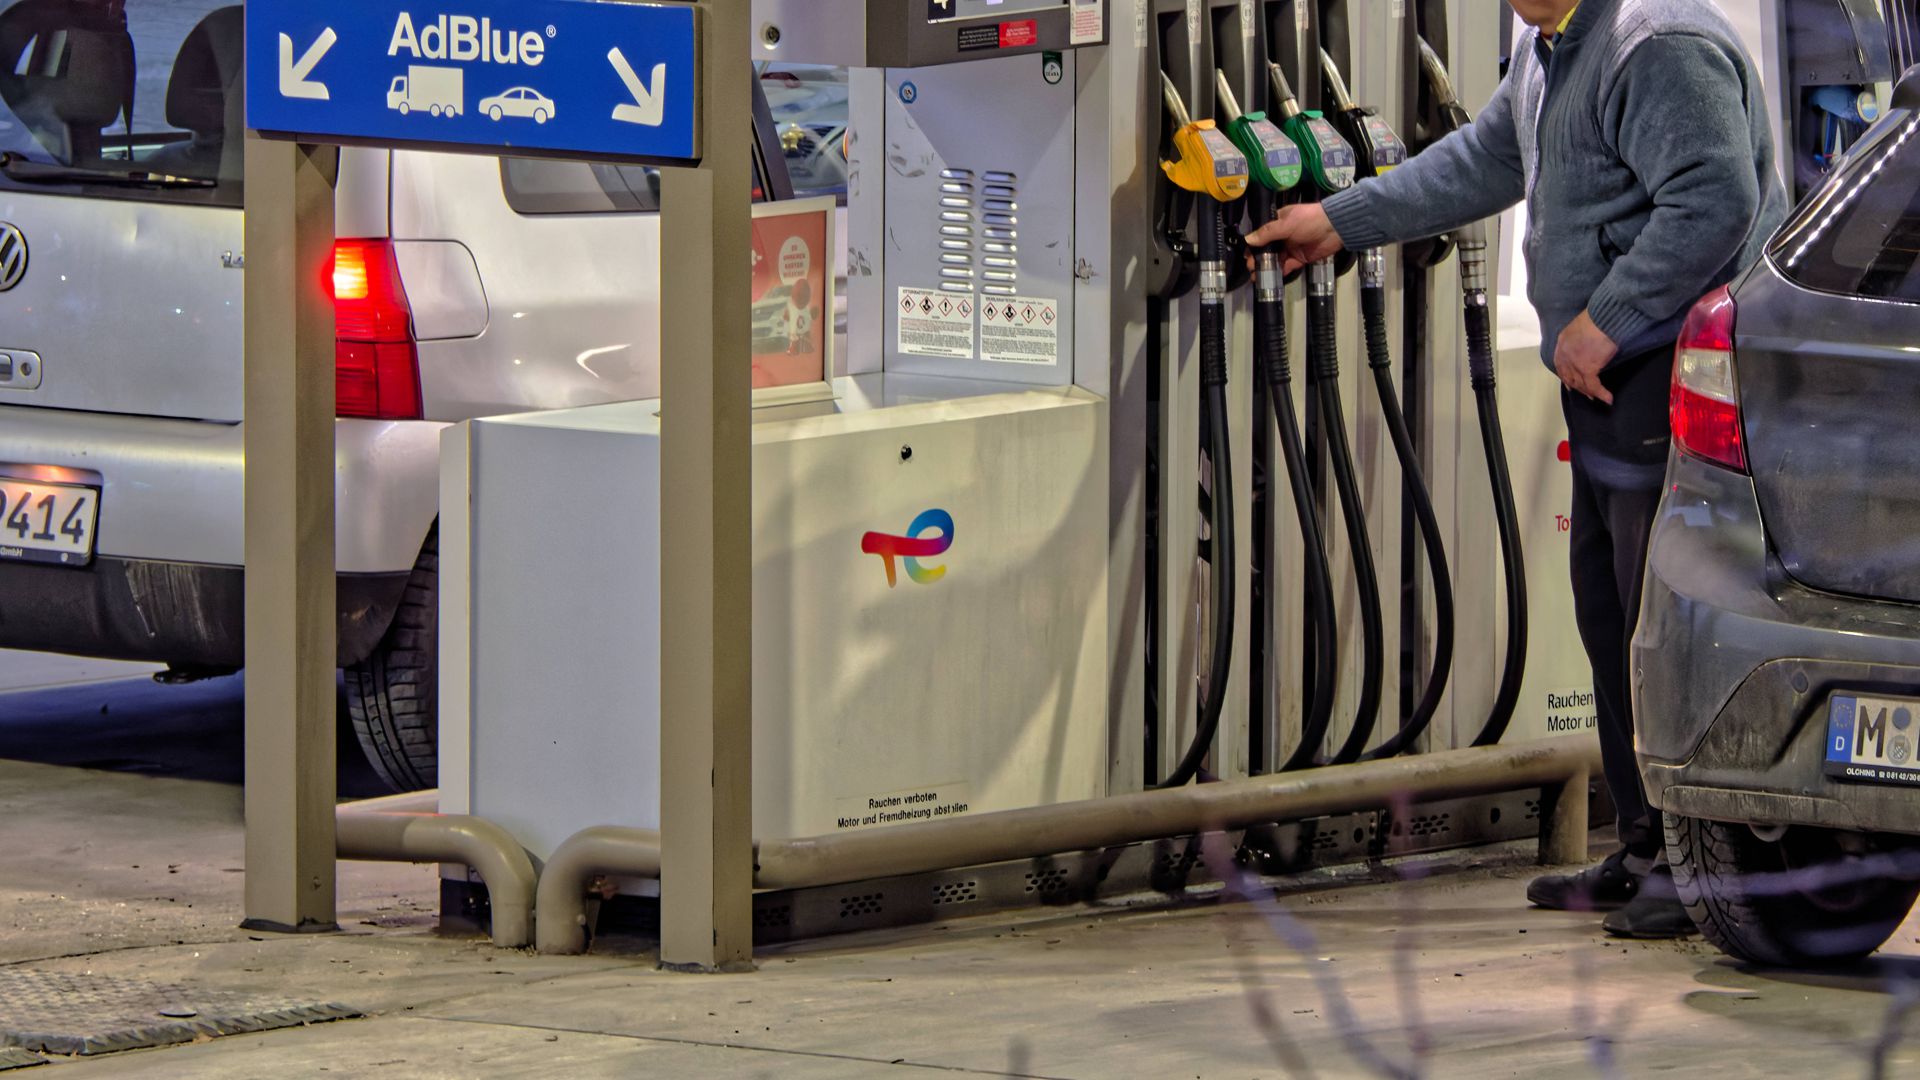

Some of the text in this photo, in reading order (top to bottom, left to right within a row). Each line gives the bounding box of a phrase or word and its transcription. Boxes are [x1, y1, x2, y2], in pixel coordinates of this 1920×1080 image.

[1555, 514, 1570, 532] To
[1547, 689, 1594, 710] Rauchen
[1547, 714, 1583, 732] Motor
[1856, 705, 1887, 758] M
[1835, 735, 1845, 751] D
[1846, 767, 1876, 778] OLCHING
[868, 791, 937, 810] Rauchen verboten
[837, 817, 860, 829] Motor
[862, 813, 877, 826] und
[879, 807, 931, 823] Fremdheizung
